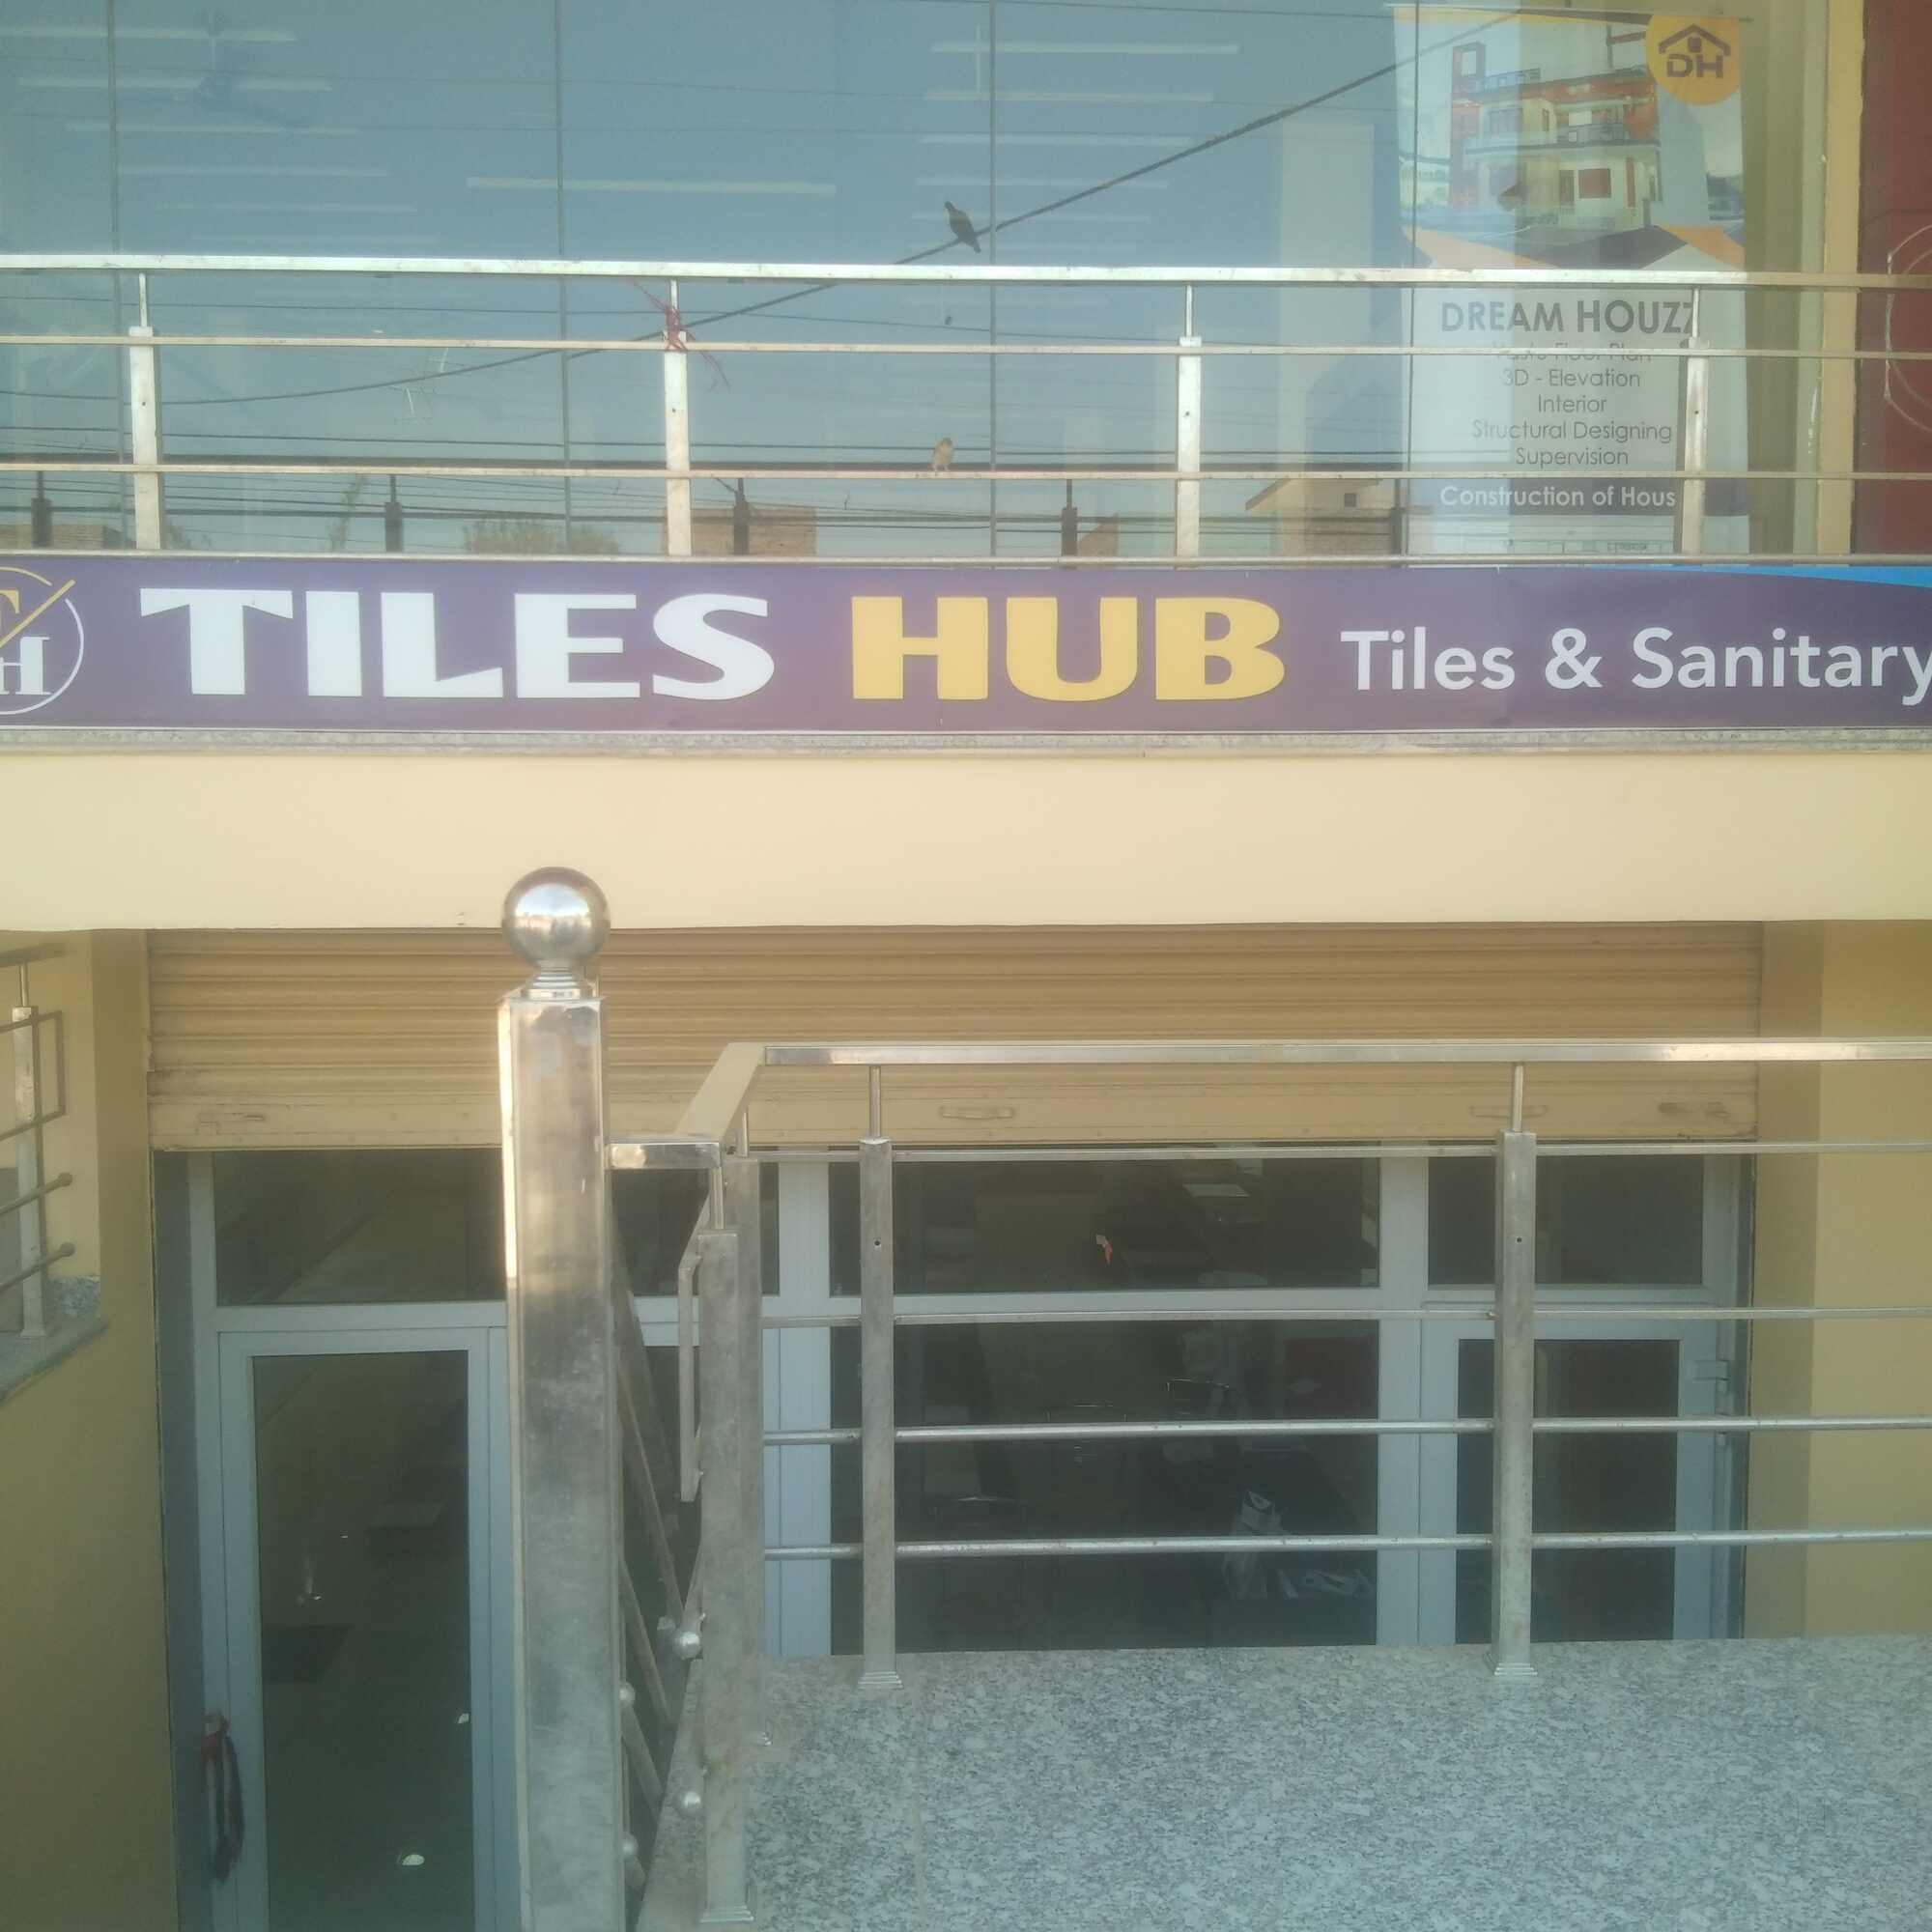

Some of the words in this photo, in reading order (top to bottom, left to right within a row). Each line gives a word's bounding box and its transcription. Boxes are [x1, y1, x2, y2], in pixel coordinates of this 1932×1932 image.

[1666, 53, 1723, 78] DH
[1441, 301, 1564, 331] DREAM
[1503, 369, 1529, 386] 3D
[1548, 368, 1640, 386] Elevation
[1538, 395, 1607, 412] Interior
[1471, 420, 1567, 440] Structural
[1574, 421, 1672, 442] Designing
[1516, 447, 1629, 468] Supervision
[1439, 486, 1584, 507] Construction
[1592, 487, 1614, 507] of
[1621, 487, 1676, 507] Hous
[140, 587, 774, 700] TILES
[851, 596, 1285, 701] HUB
[1340, 627, 1516, 691] Tiles
[1545, 628, 1603, 690] &
[1632, 627, 1932, 706] Sanitary
